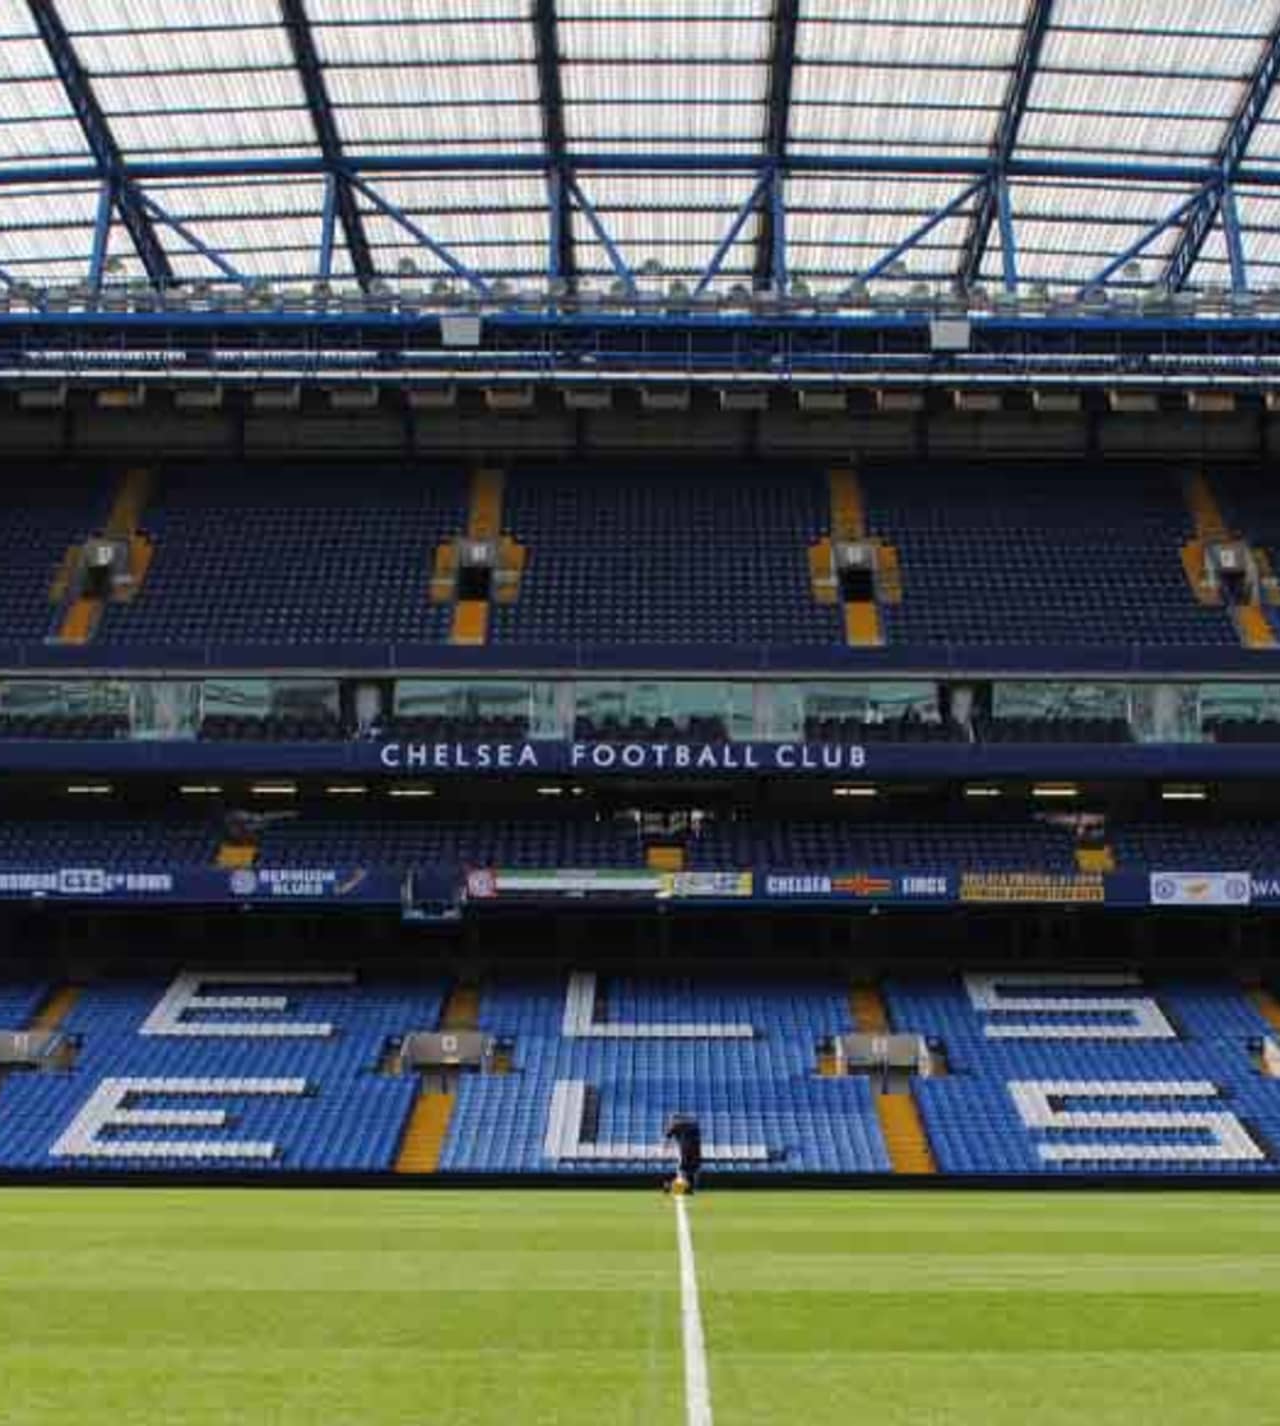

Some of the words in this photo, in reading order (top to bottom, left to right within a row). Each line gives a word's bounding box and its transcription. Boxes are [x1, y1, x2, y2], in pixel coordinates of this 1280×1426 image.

[380, 744, 538, 767] CHELSEA
[571, 744, 758, 767] FOOTBALL
[776, 744, 866, 767] CLUB
